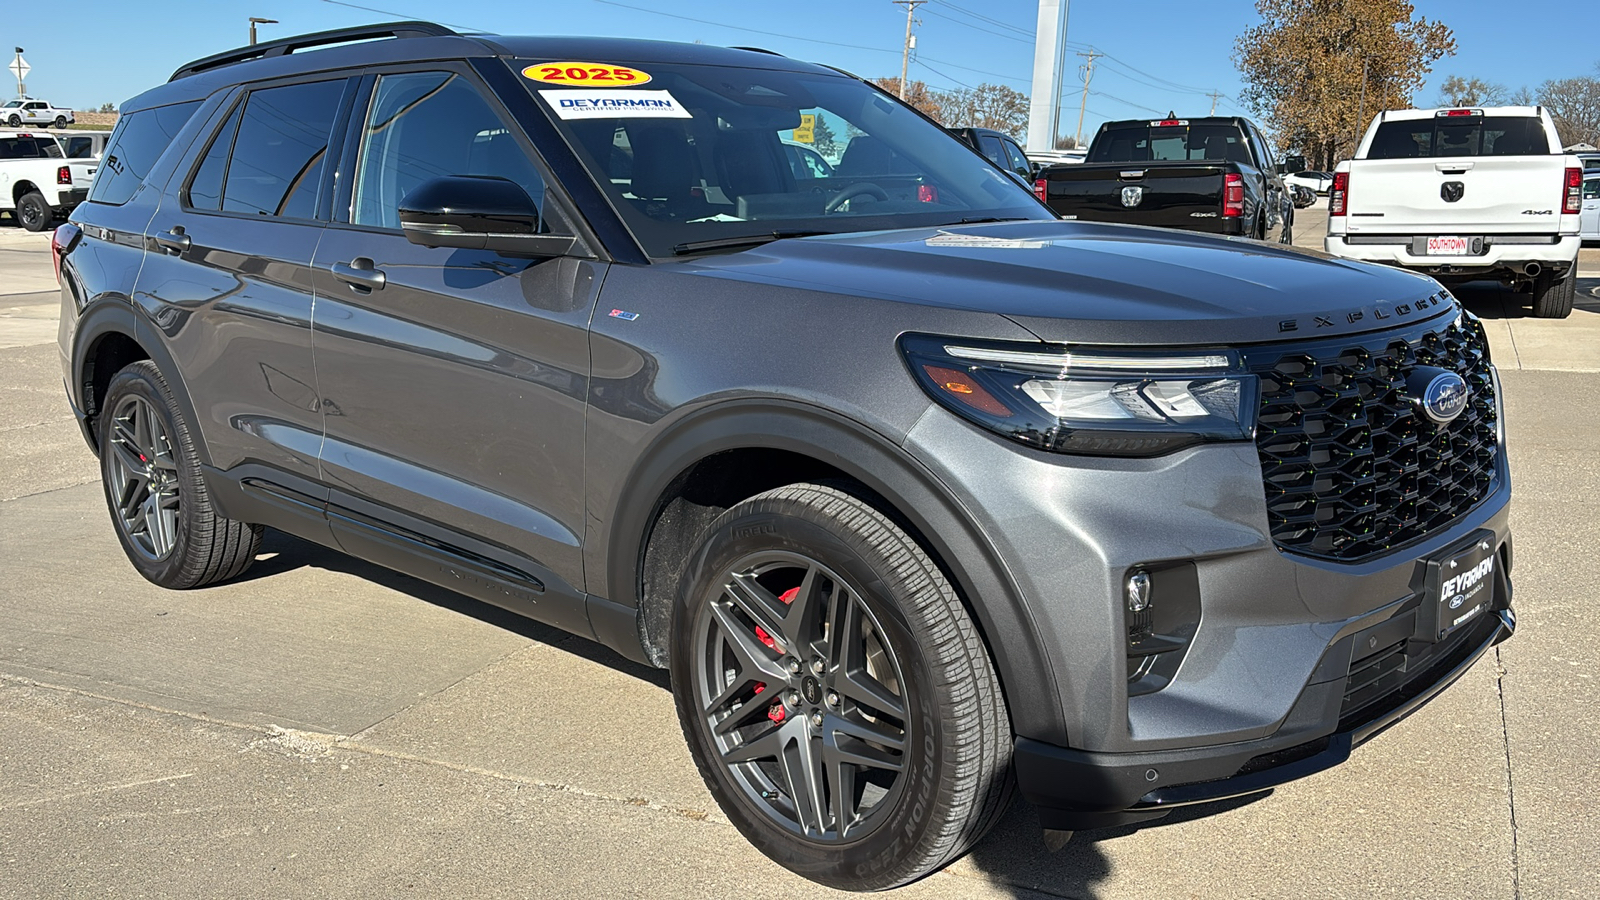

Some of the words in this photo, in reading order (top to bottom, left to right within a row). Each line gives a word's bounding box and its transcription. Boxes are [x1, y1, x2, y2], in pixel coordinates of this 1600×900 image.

[540, 67, 637, 81] 2025
[559, 98, 672, 108] DEYARMAN
[1428, 238, 1467, 250] SOUTHTOWN
[1277, 289, 1450, 333] EXPLORER
[729, 524, 778, 541] PIRELLI
[1440, 554, 1495, 603] DEYARMAN
[904, 694, 936, 839] SCORPION
